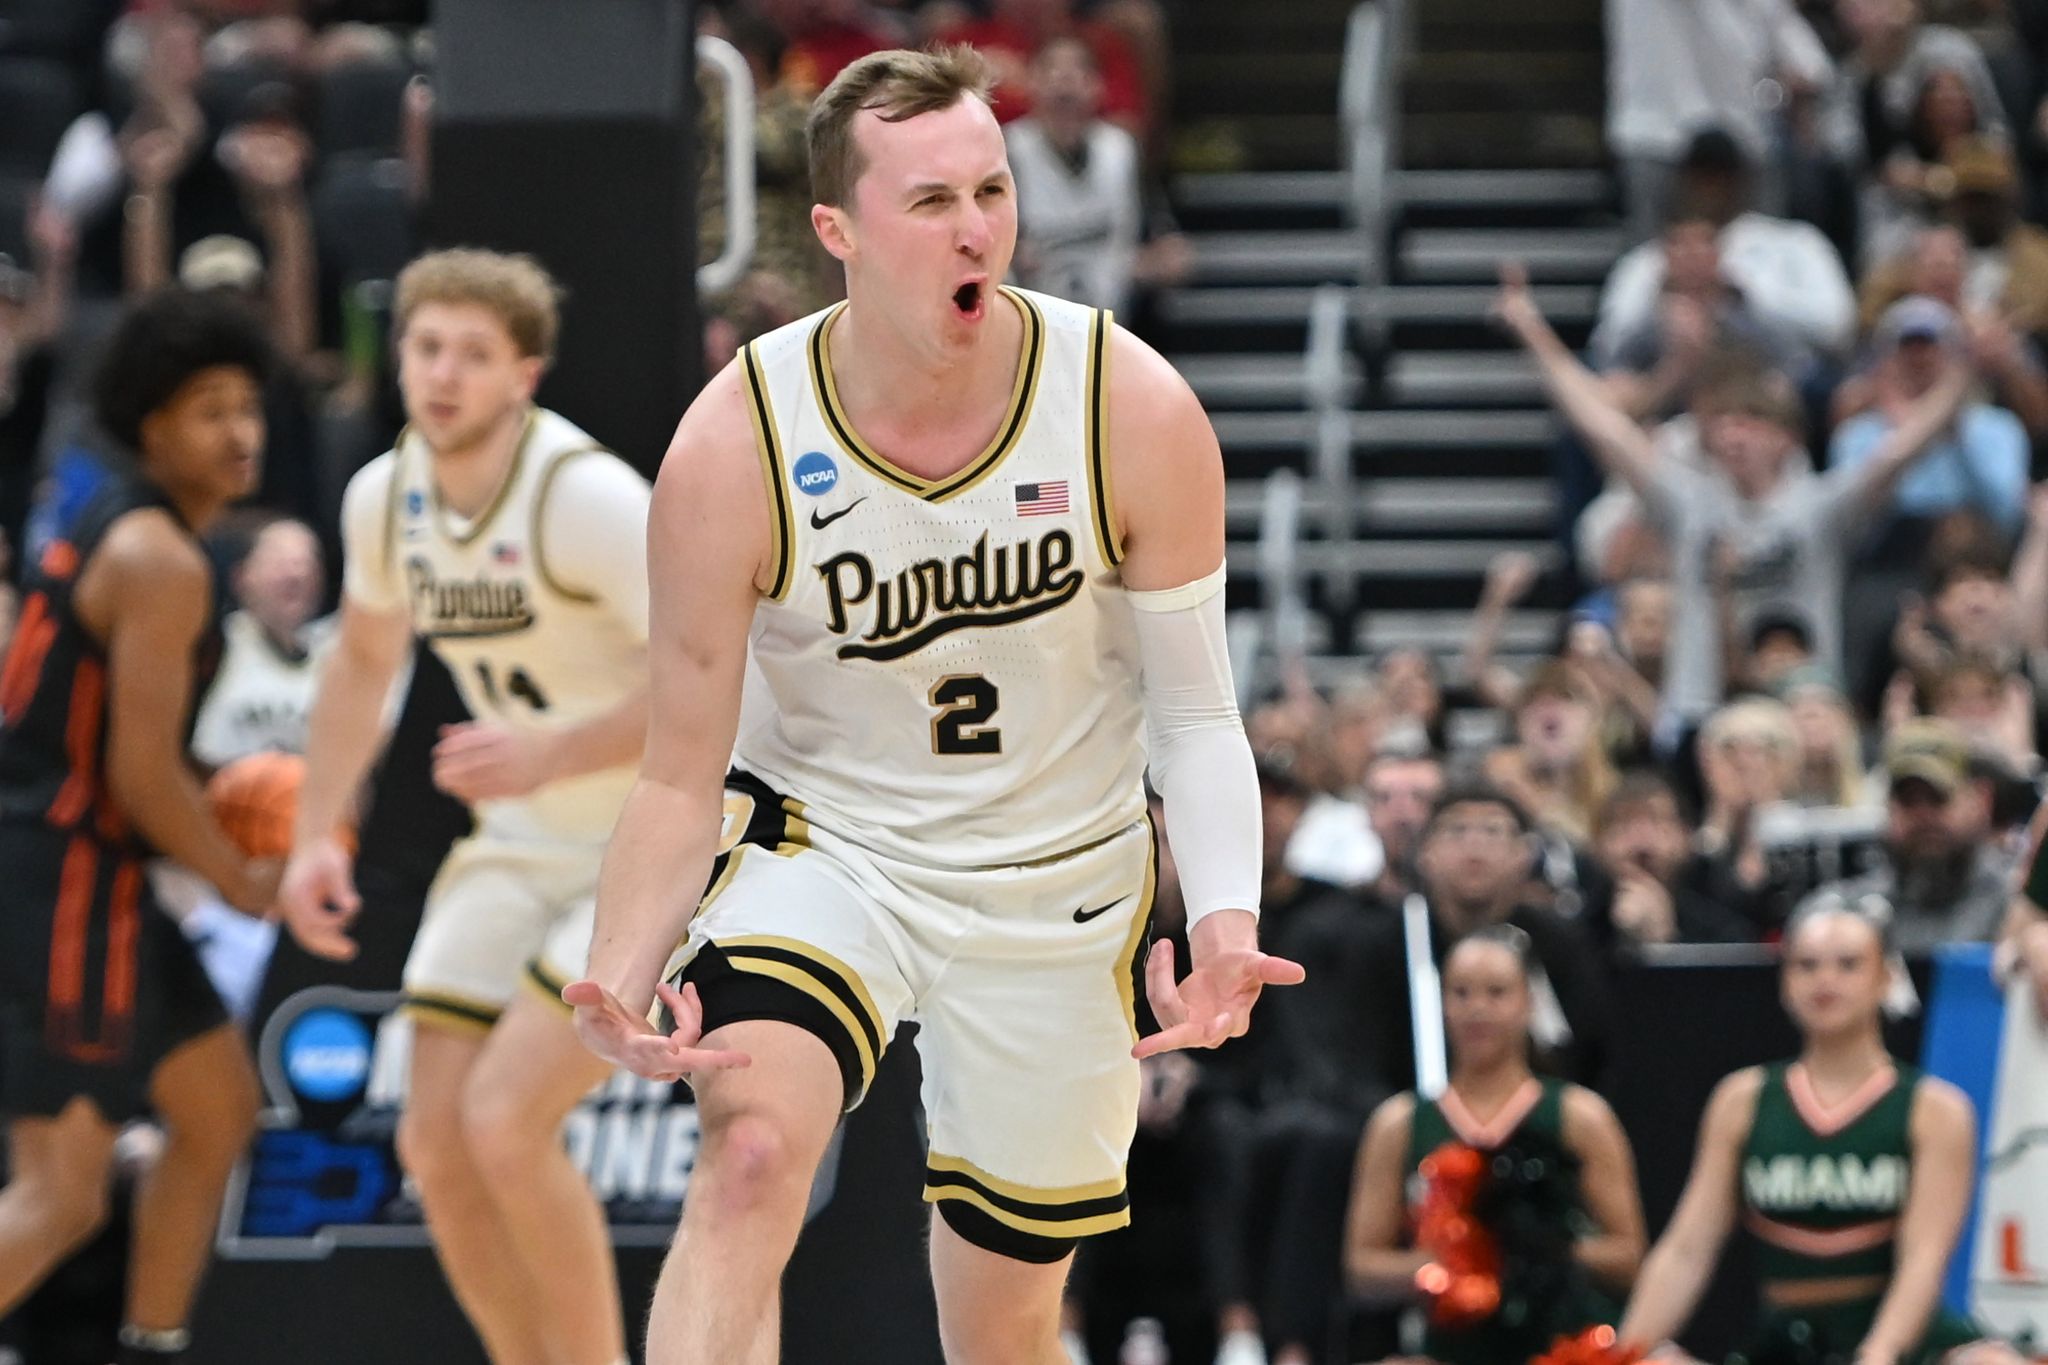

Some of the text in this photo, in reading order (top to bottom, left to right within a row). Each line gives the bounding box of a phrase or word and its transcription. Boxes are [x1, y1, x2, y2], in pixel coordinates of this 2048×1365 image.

[800, 469, 836, 487] NCAA
[812, 528, 1085, 661] Purdue
[928, 672, 1002, 755] 2
[1743, 1152, 1908, 1211] MIAMI
